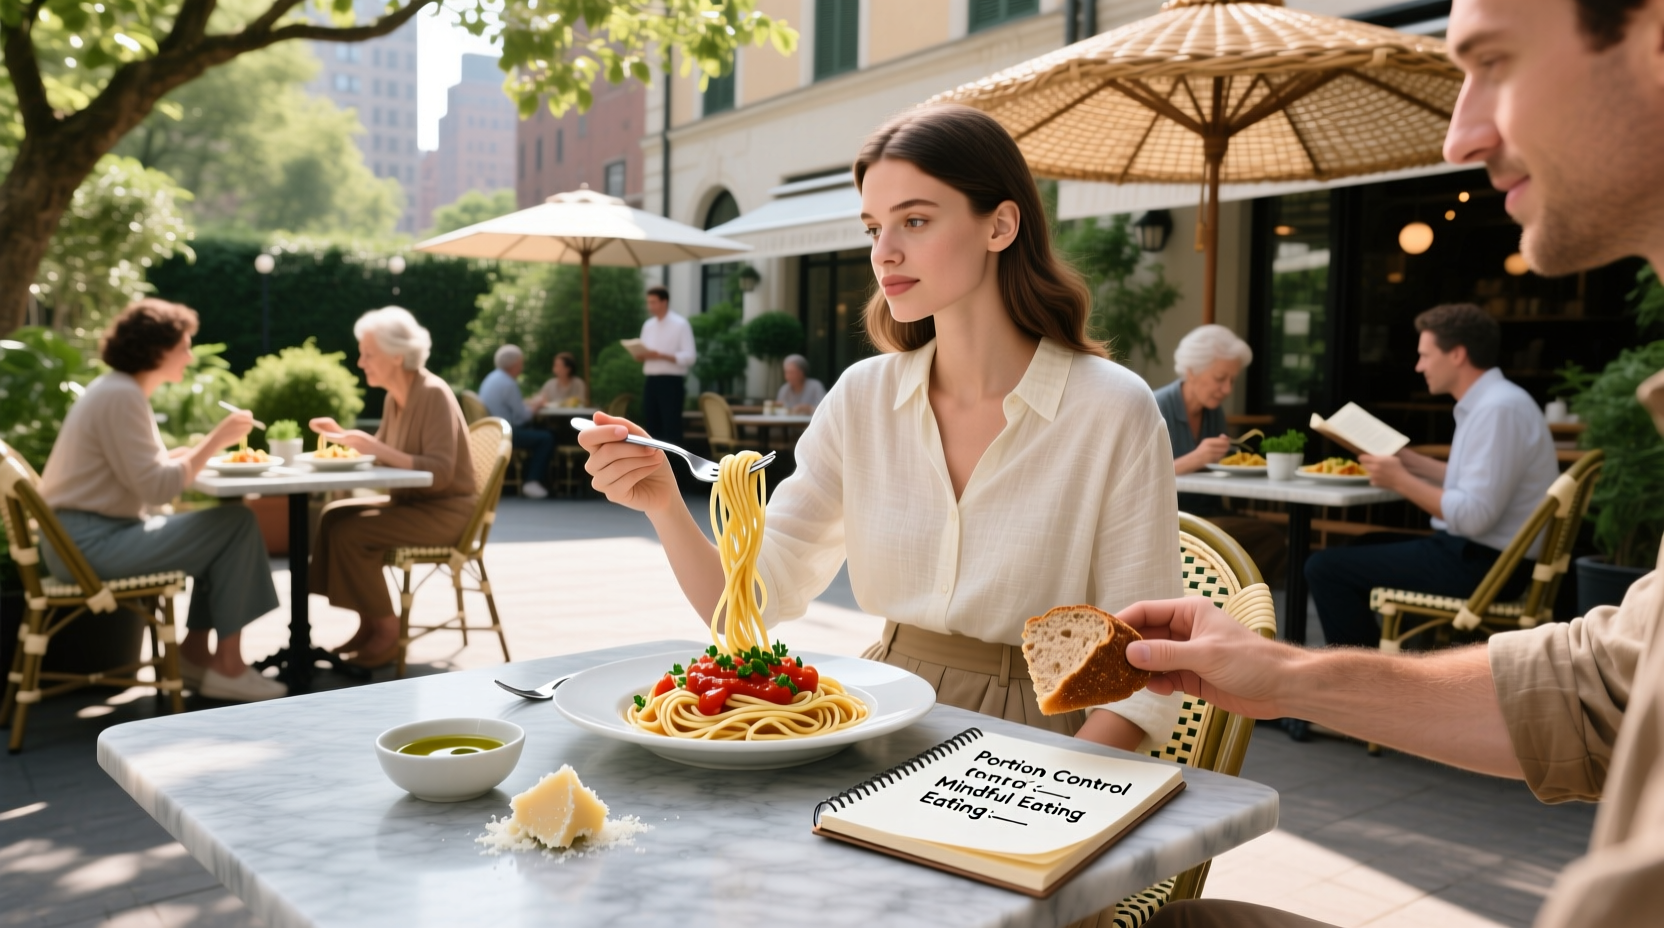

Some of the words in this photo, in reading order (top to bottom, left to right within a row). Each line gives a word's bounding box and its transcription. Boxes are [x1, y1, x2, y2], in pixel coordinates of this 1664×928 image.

[973, 750, 1046, 778] Portion
[1053, 769, 1133, 796] Control
[935, 775, 1015, 805] Mindful
[1017, 796, 1087, 823] Eating
